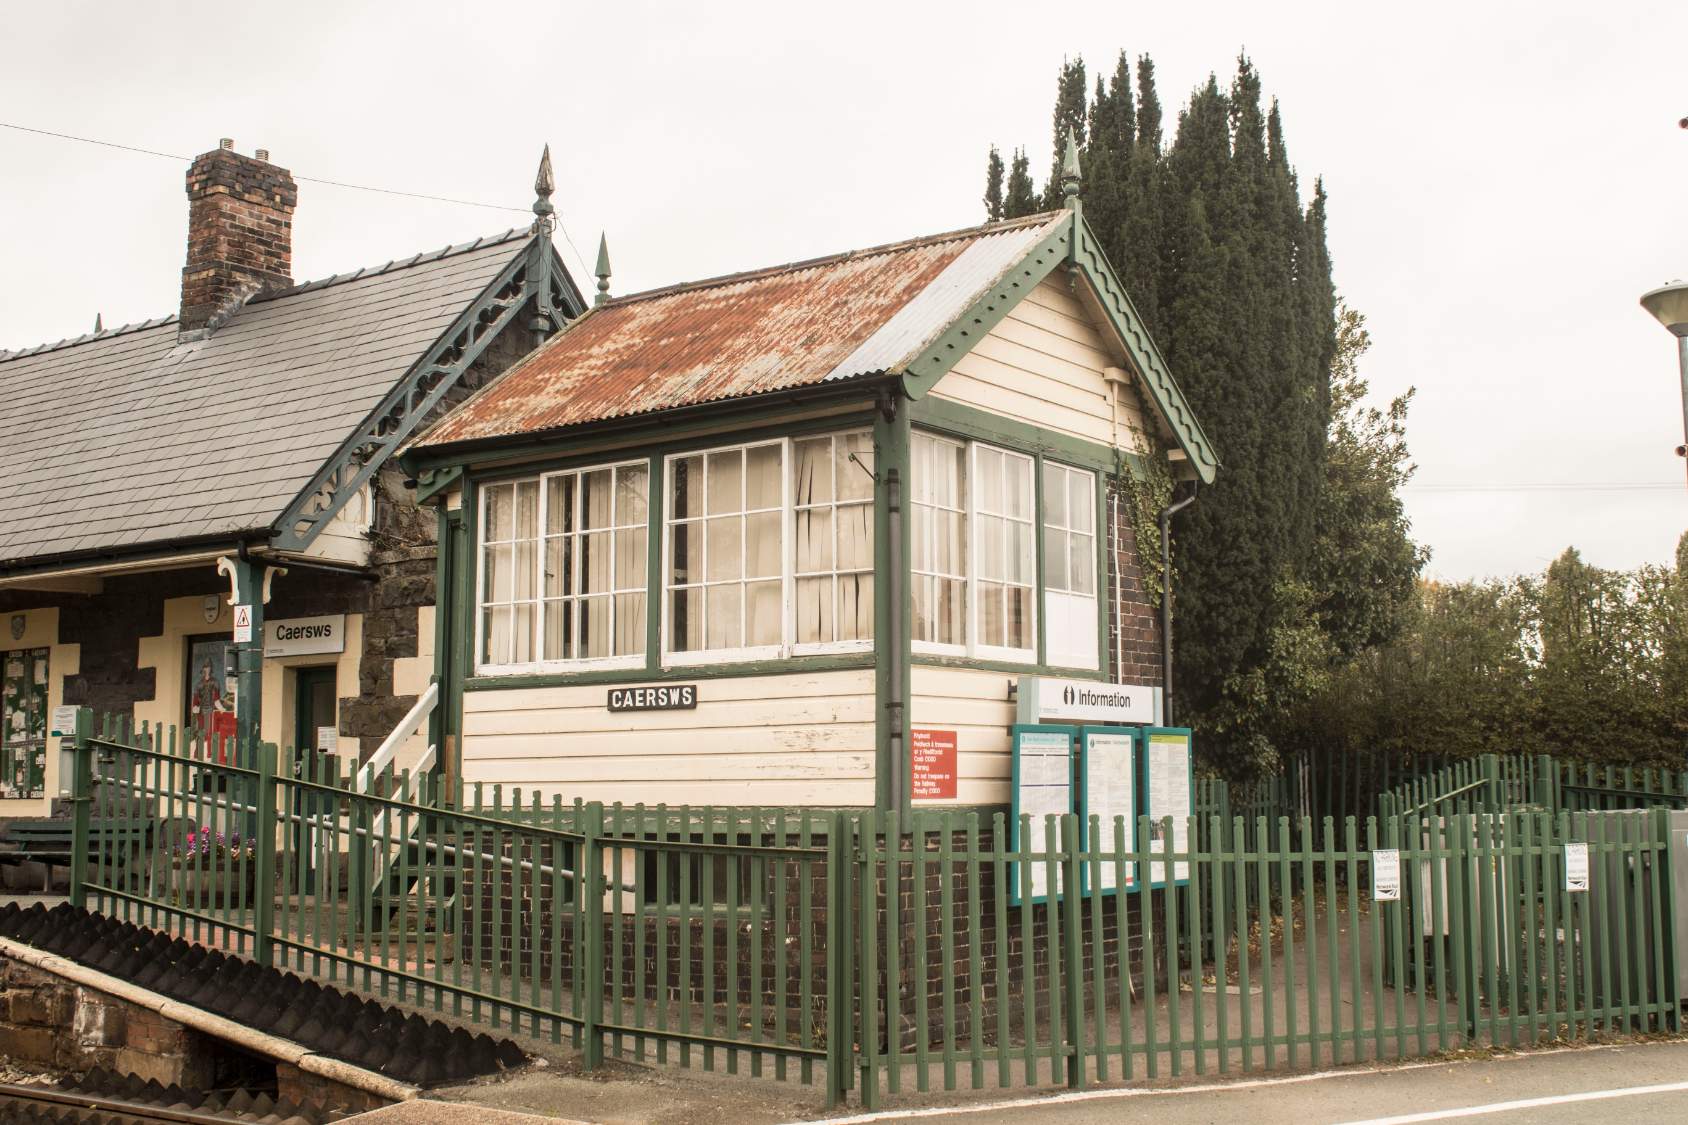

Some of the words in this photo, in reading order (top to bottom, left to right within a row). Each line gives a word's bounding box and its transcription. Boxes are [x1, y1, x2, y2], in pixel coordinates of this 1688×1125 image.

[276, 624, 332, 640] Caersws
[611, 686, 692, 708] CAERSWS
[1078, 688, 1131, 708] Information
